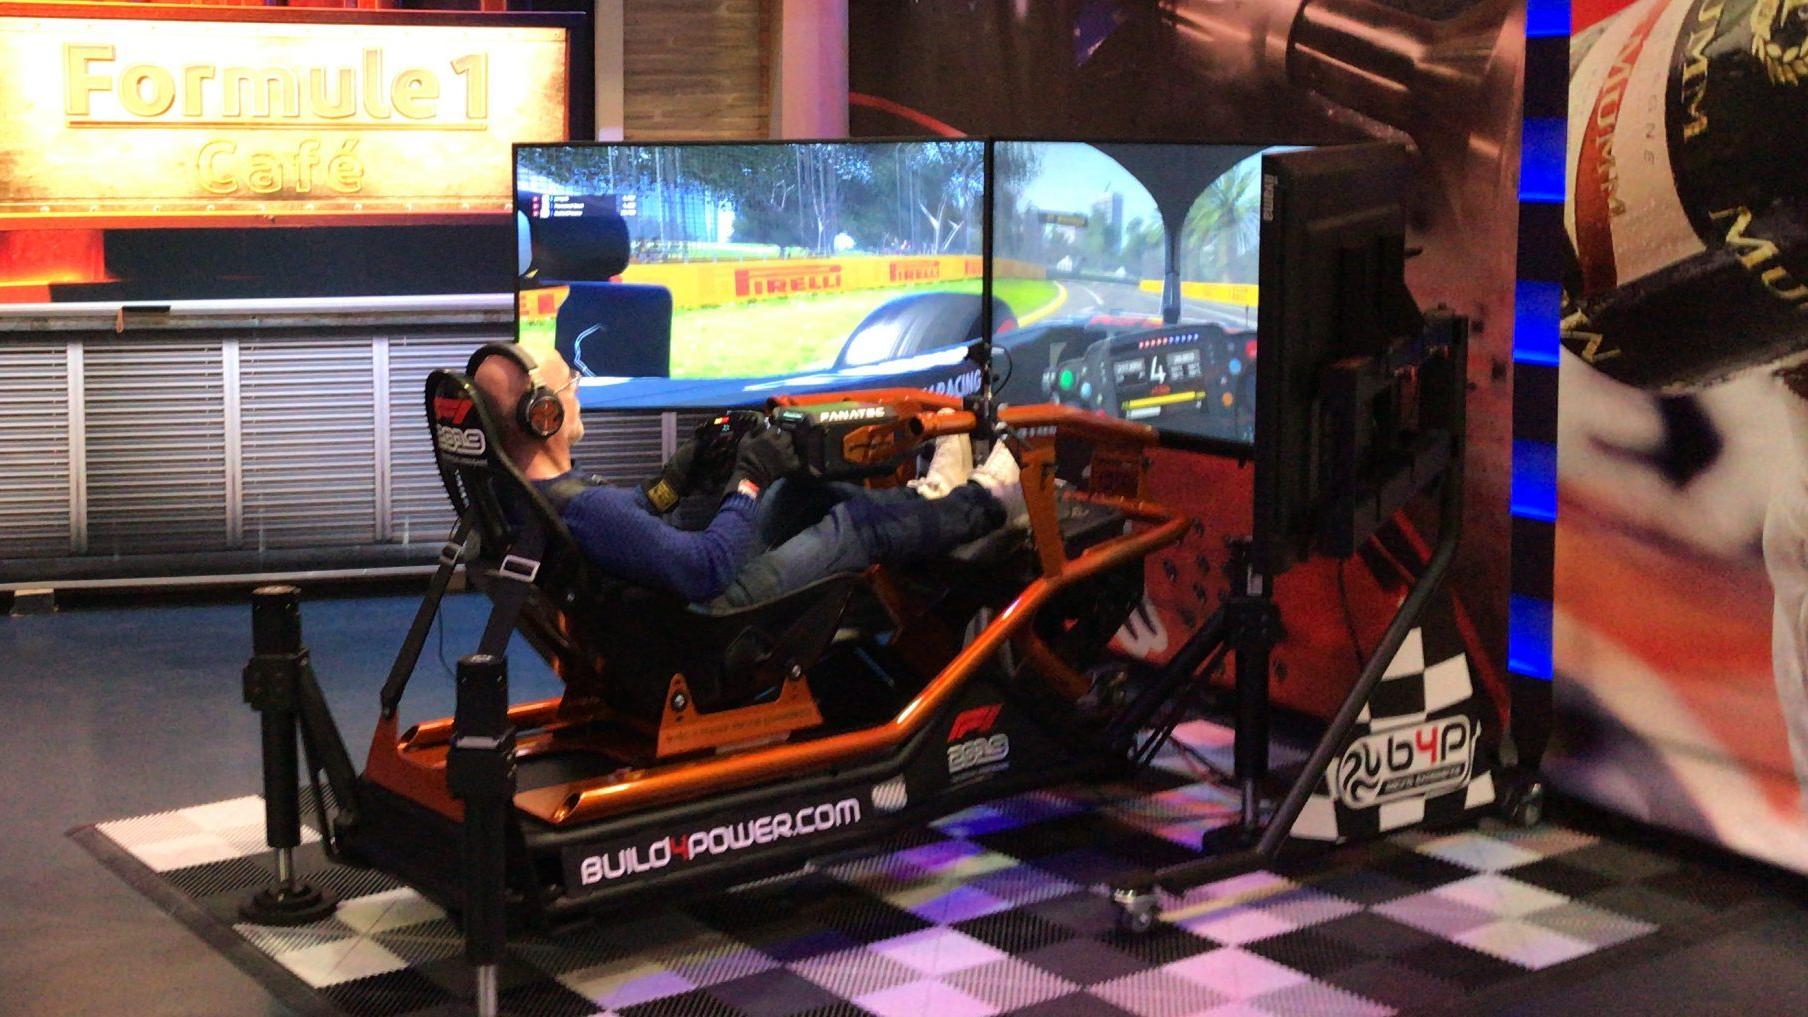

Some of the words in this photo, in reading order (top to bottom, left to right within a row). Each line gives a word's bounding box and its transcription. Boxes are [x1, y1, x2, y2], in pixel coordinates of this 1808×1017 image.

[196, 137, 365, 195] Café
[734, 265, 842, 297] PIRELLI
[1150, 355, 1167, 385] 4
[820, 406, 886, 423] FANATEC
